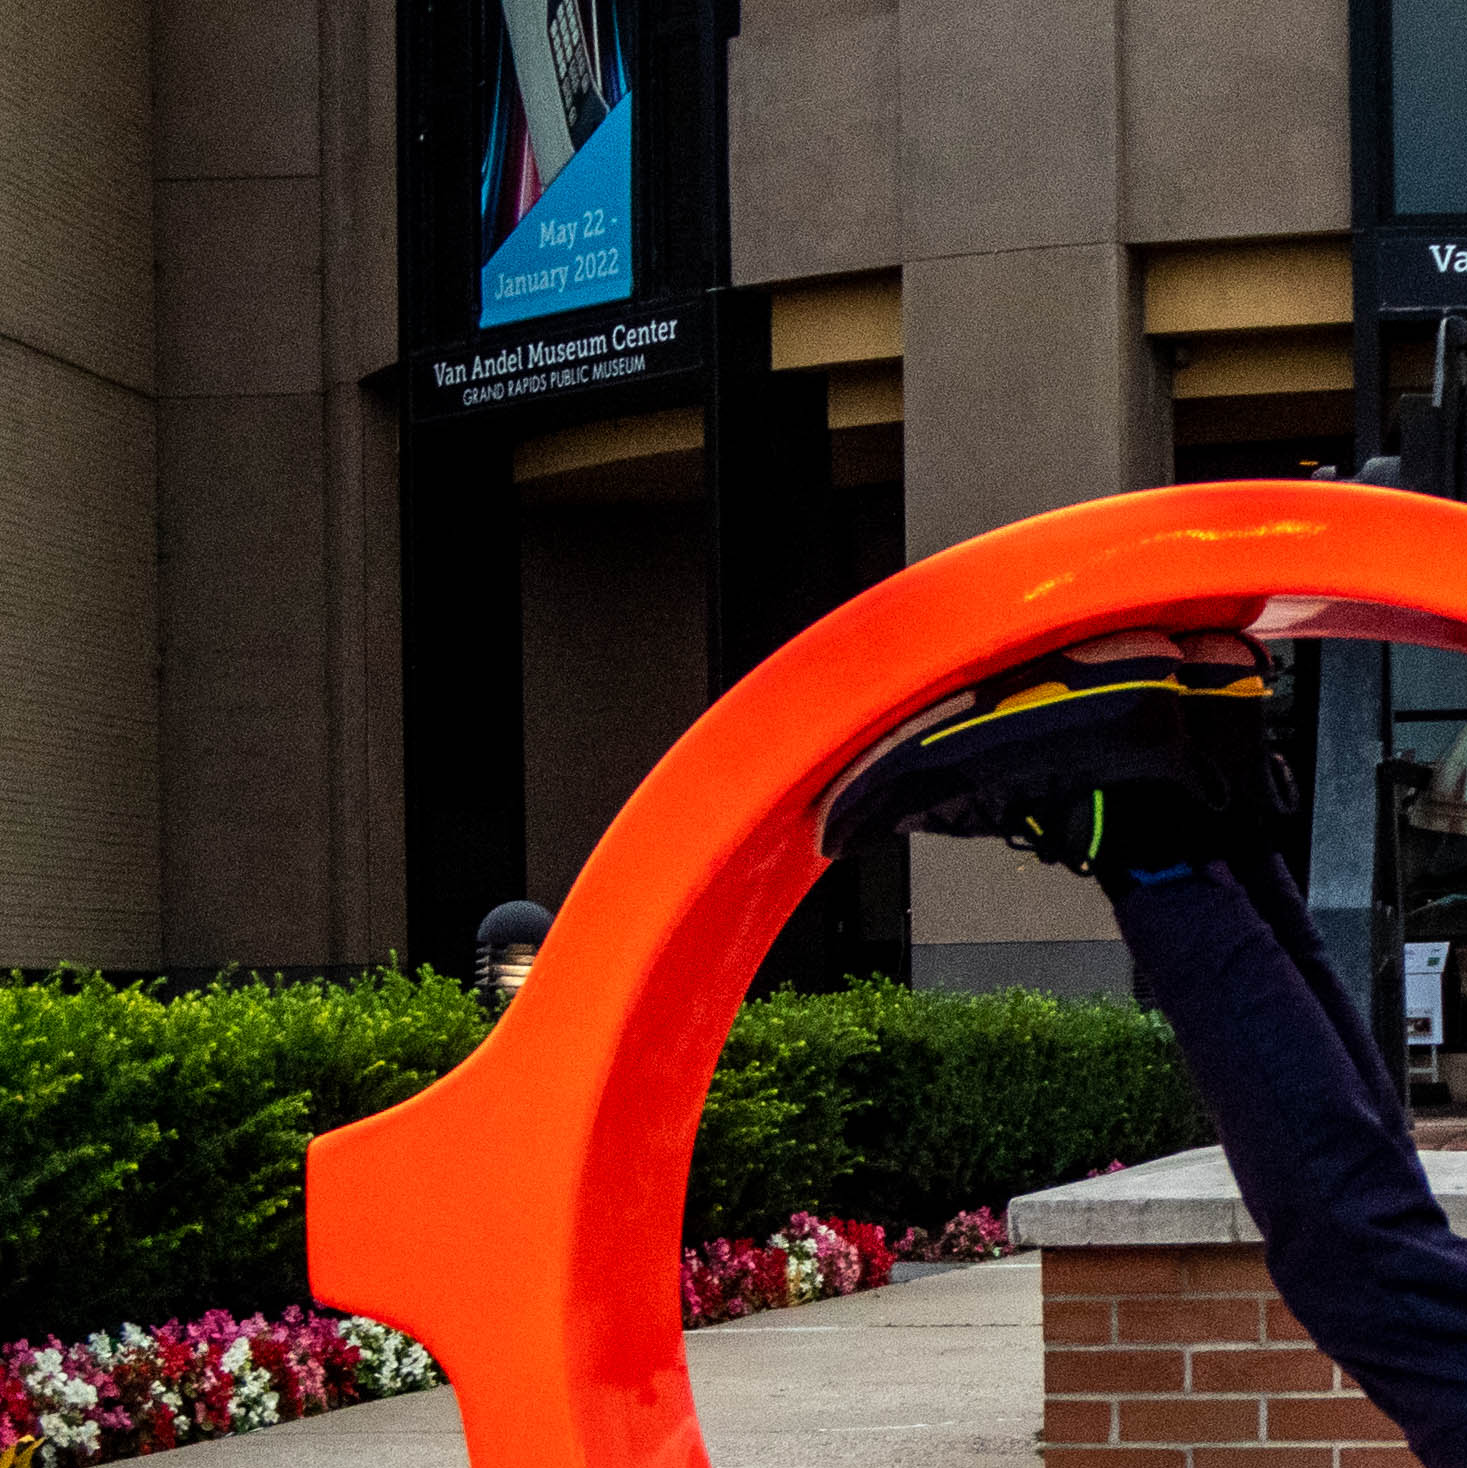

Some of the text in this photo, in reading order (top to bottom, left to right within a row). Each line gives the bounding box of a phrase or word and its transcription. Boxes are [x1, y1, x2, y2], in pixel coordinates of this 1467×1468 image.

[540, 220, 578, 249] May
[584, 209, 605, 238] 22
[495, 248, 619, 299] January 2022
[434, 319, 678, 387] Van Andel Museum Center
[462, 353, 646, 406] GRAND RAPIDS PUBLIC MUSEUM
